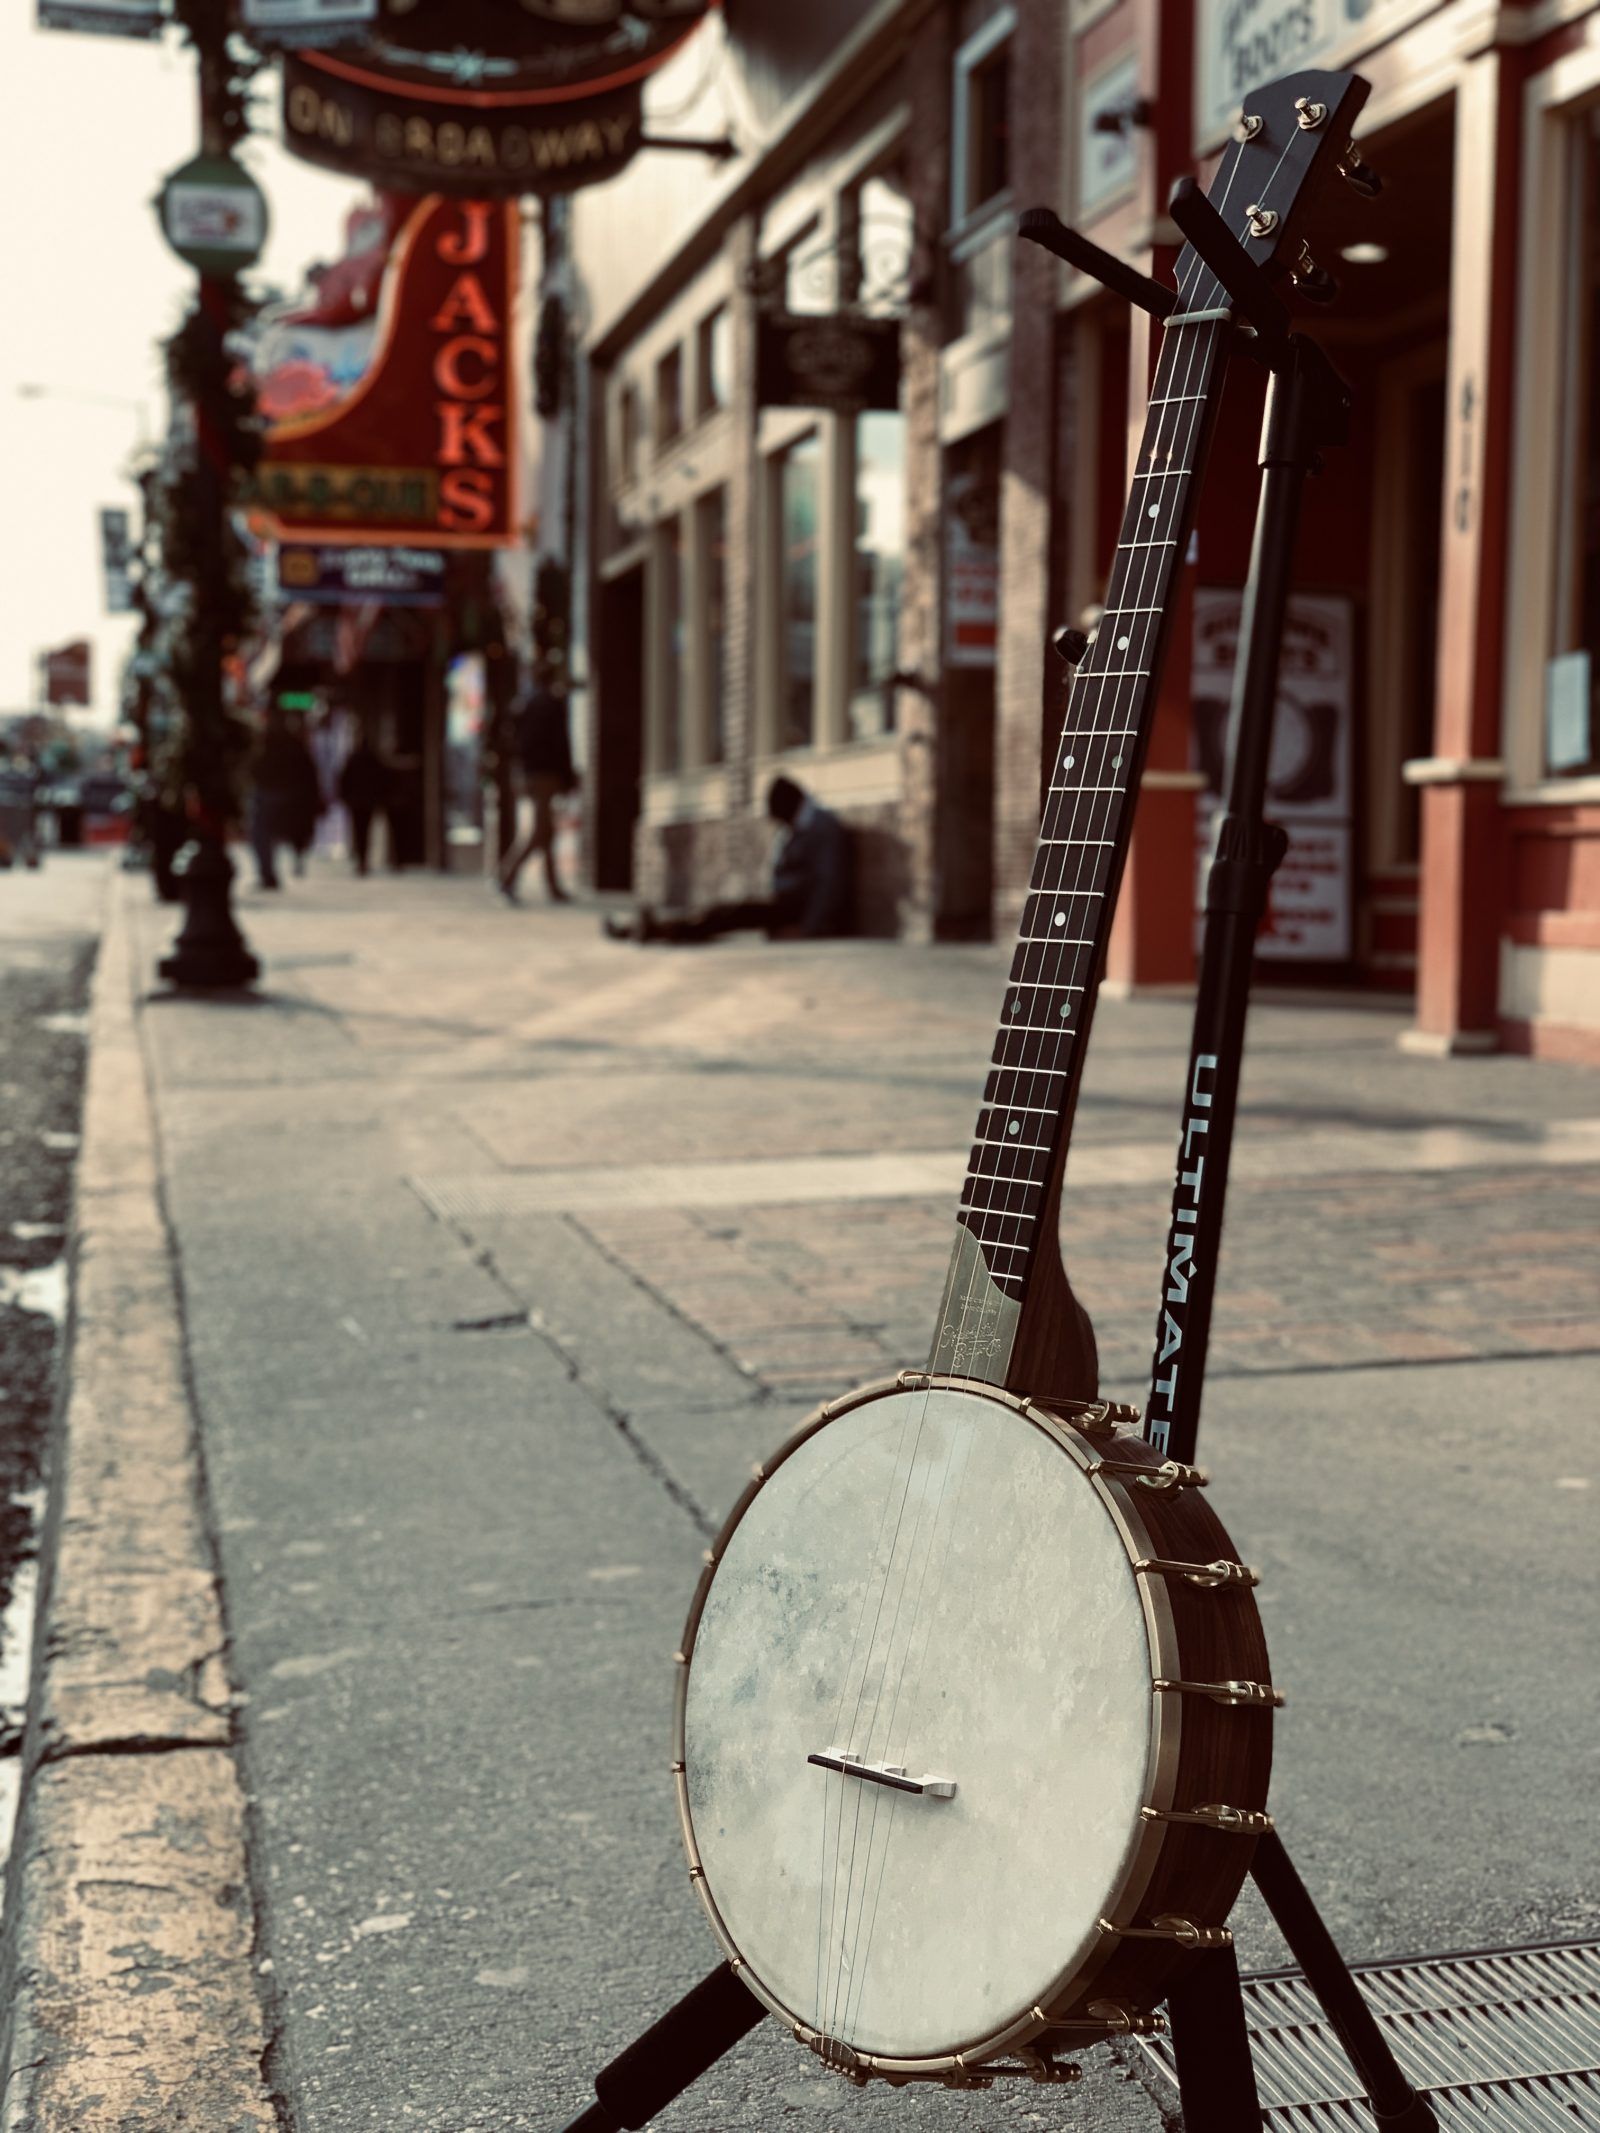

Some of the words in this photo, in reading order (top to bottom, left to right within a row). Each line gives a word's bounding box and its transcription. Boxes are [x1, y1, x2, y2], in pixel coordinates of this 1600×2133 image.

[288, 85, 352, 146] ON
[375, 113, 633, 170] BROADWAY
[434, 200, 502, 532] JACKS
[1148, 1054, 1218, 1456] ULTIMATE
